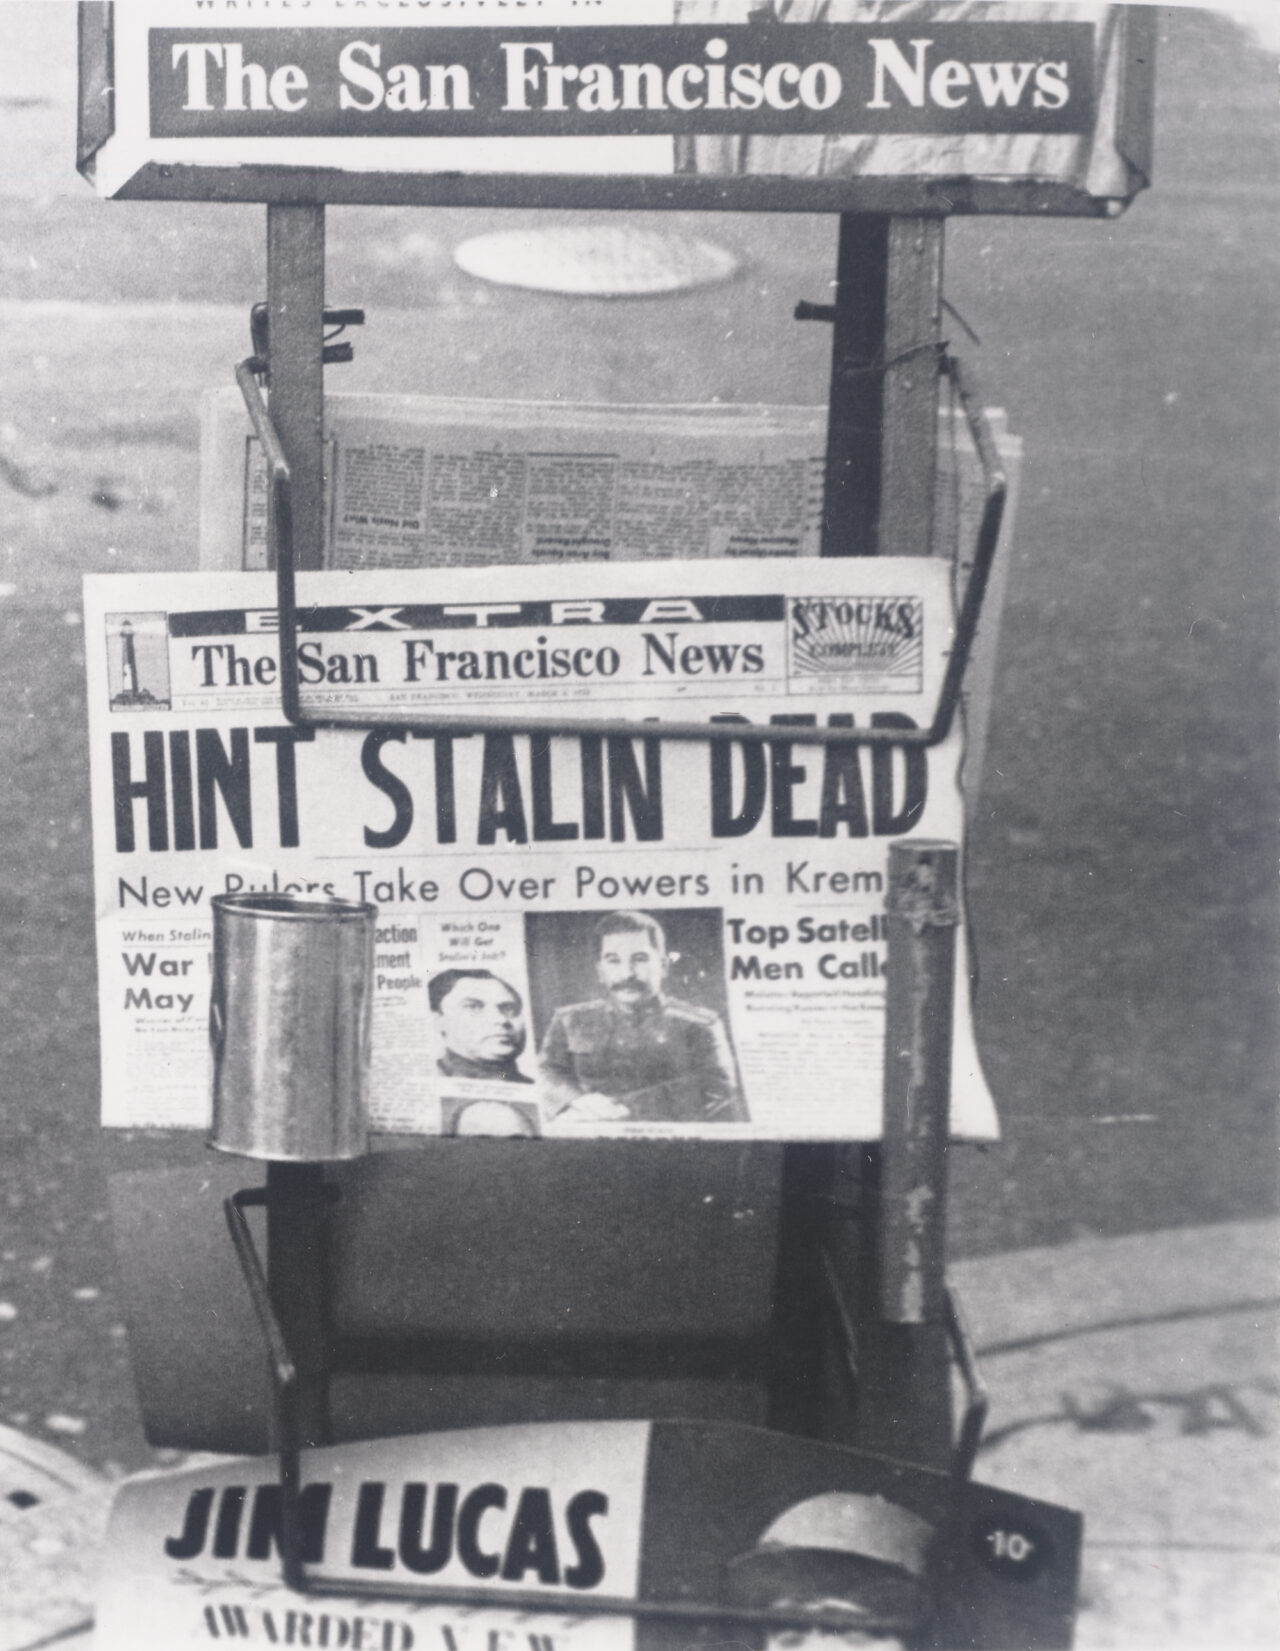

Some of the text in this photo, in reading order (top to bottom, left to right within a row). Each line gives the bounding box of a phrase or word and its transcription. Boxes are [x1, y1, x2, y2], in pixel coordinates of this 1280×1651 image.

[172, 38, 1070, 112] The San Francisco News
[245, 600, 704, 633] EXTRA
[793, 602, 915, 640] STOCKS
[192, 633, 765, 688] The San Francisco News
[111, 712, 929, 853] HINT STALIN DEAD
[119, 875, 204, 909] New
[353, 866, 440, 903] Take
[459, 867, 557, 902] Over
[576, 866, 710, 899] Powers
[730, 862, 764, 895] in
[786, 860, 883, 894] Krem
[122, 927, 212, 943] When Stalin
[441, 921, 501, 933] Which One
[449, 936, 494, 947] Will Get
[726, 917, 790, 950] Top
[121, 952, 194, 977] War
[730, 954, 804, 981] Men
[377, 975, 422, 991] People
[124, 987, 195, 1014] May
[165, 1481, 609, 1590] JIM LUCAS
[200, 1603, 414, 1651] AWARDED
